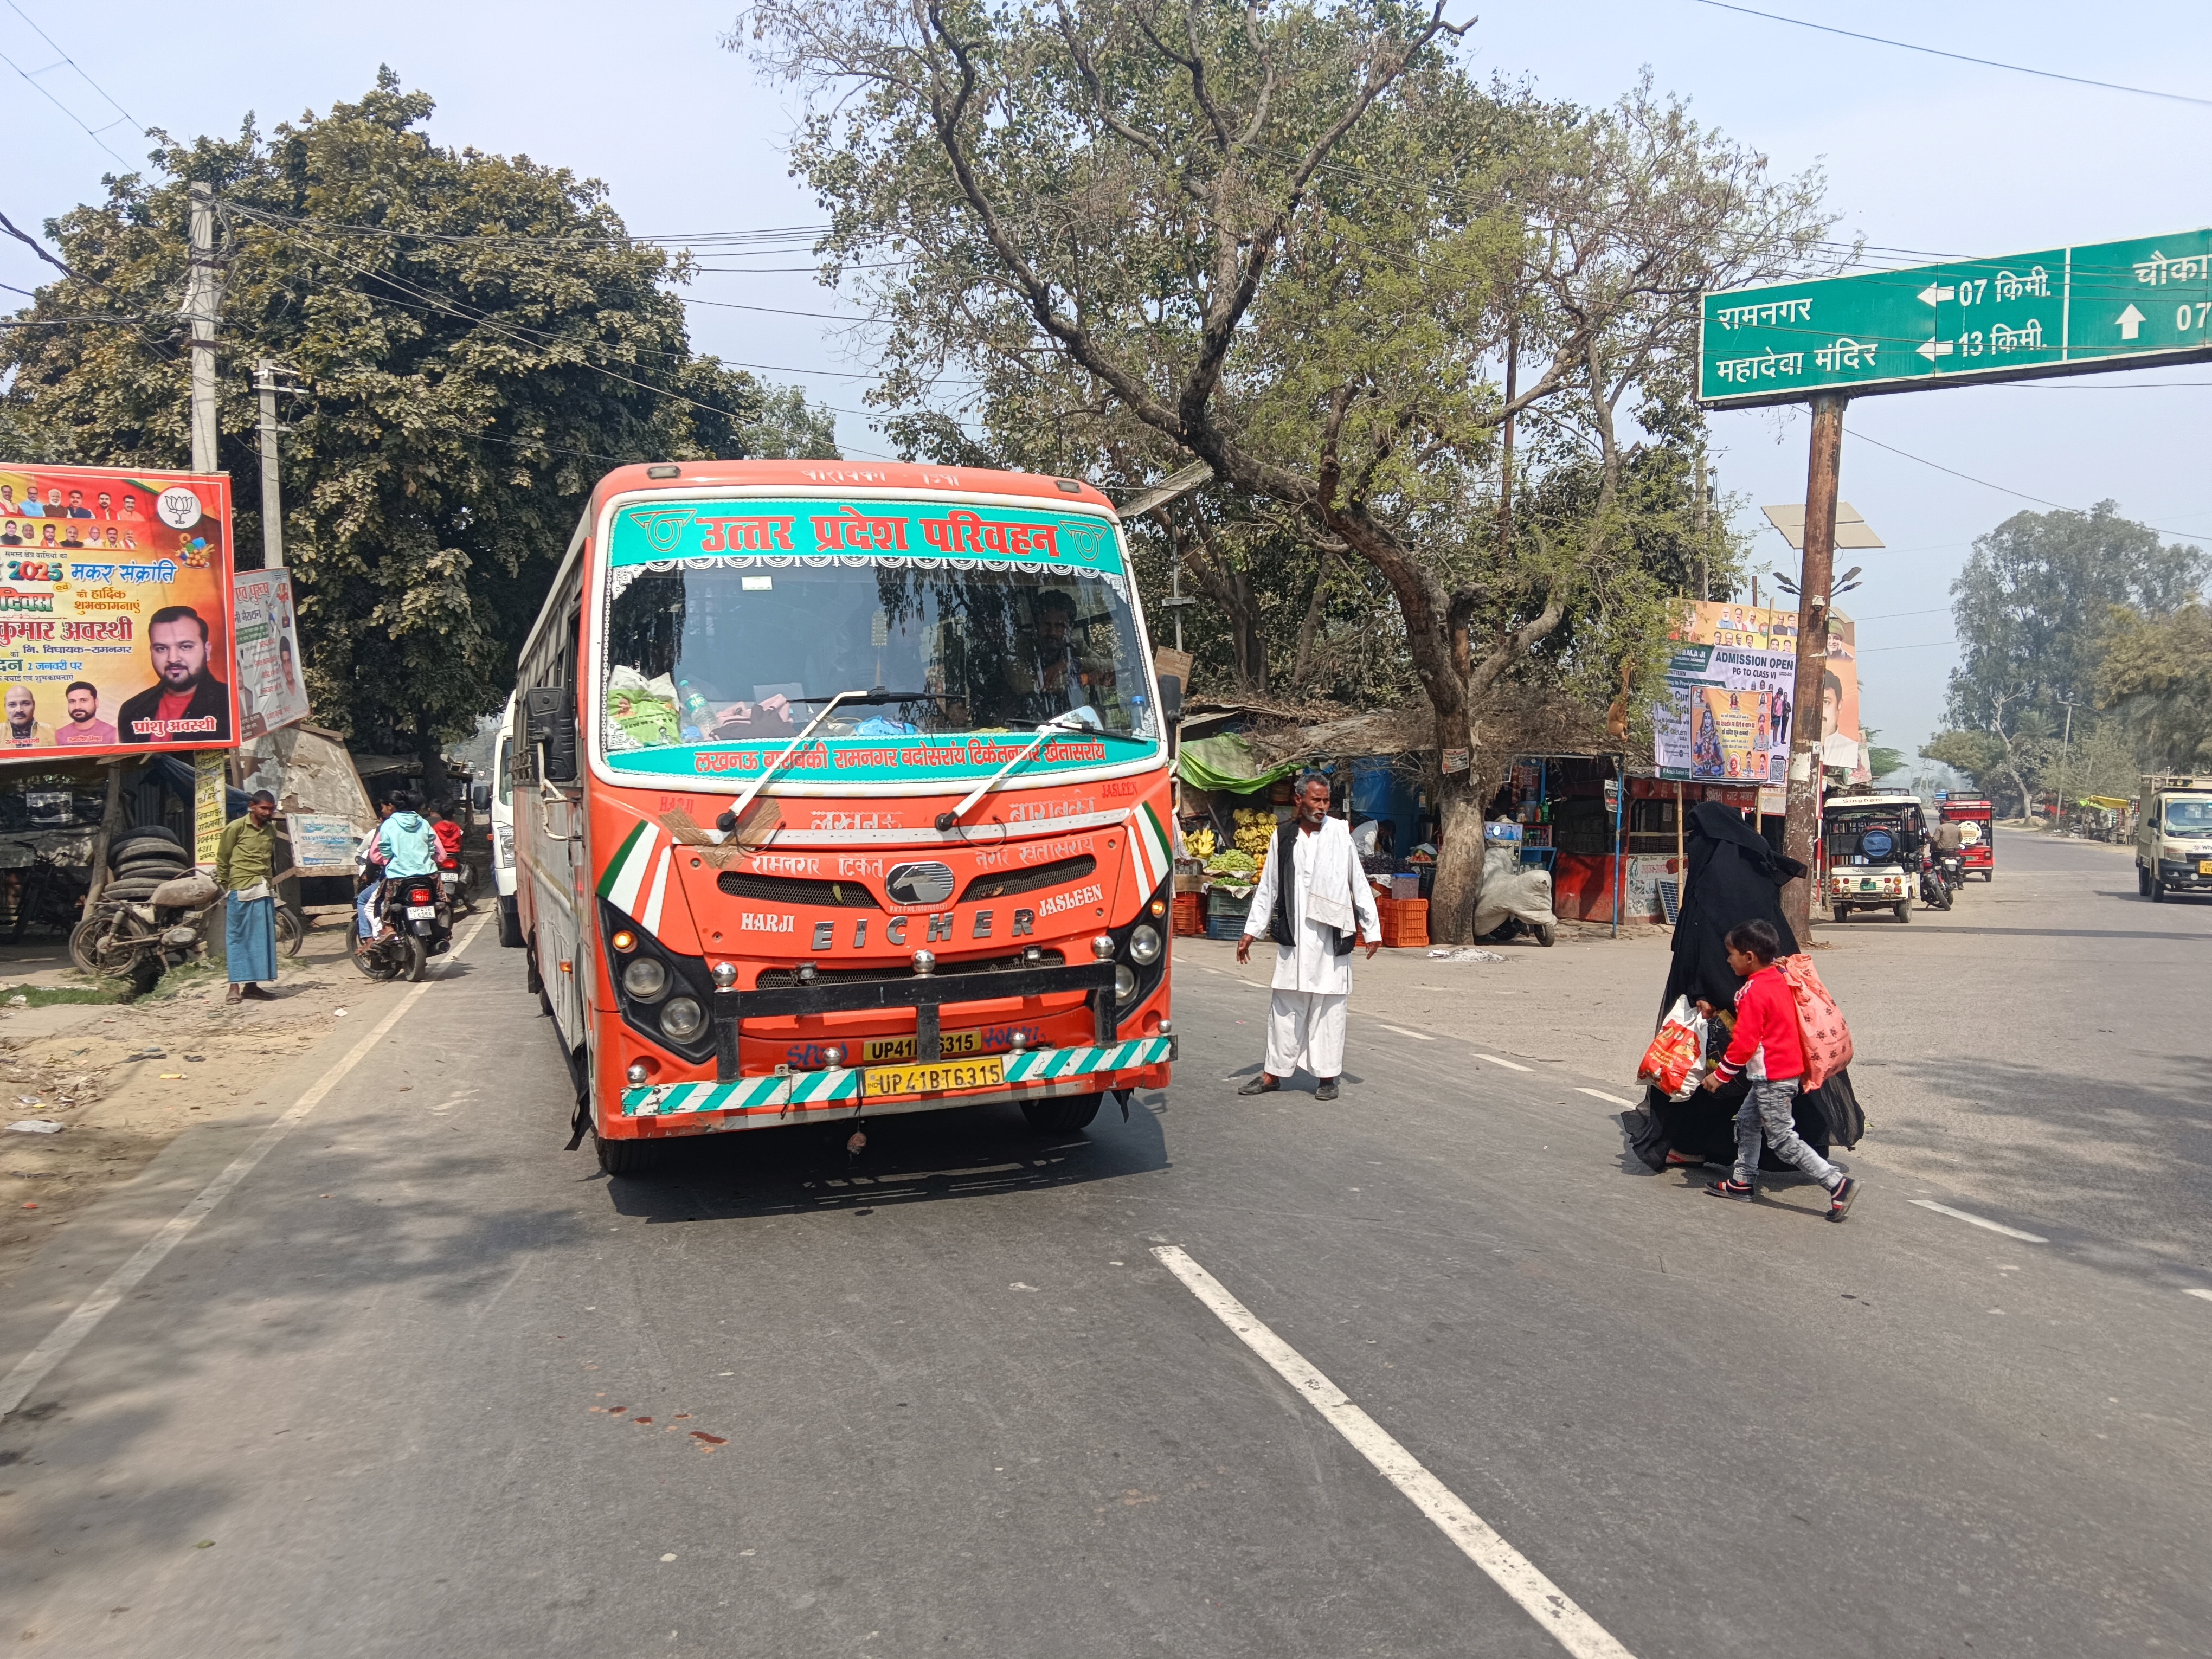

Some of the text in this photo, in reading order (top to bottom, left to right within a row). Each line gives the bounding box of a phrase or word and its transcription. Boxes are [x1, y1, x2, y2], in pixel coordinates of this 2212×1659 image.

[1959, 265, 2051, 306] 07 किमी.
[1717, 298, 1813, 330] रामनगर
[2177, 302, 2212, 331] 07
[1959, 318, 2047, 357] 13 किमी.
[1716, 338, 1879, 383] महादेवा मंदिर
[695, 506, 1060, 557] उत्तर प्रदेश परिवहन
[7, 561, 63, 582] 2025
[71, 564, 115, 583] मकर
[119, 560, 177, 583] संक्रांति
[0, 587, 54, 612] दिवस
[91, 587, 127, 599] हार्दिक
[74, 599, 141, 615] शुभकामनाएं
[0, 616, 133, 646] कुमार अवस्थी
[35, 660, 67, 670] जनवरी
[70, 662, 82, 670] पर
[1715, 652, 1794, 670] ADMISSION OPEN
[1733, 667, 1741, 676] PG
[1743, 668, 1751, 677] TO
[1753, 670, 1769, 678] CLASS
[1770, 671, 1776, 679] VI
[133, 716, 215, 736] प्रांशु अवस्थी
[695, 750, 759, 771] लखनऊ
[833, 748, 898, 768] रामनगर
[901, 741, 966, 766] बदोसरांय
[1102, 782, 1137, 798] JASLEEN
[1727, 791, 1738, 801] चाट
[752, 856, 821, 875] रामनगर
[1039, 884, 1104, 917] JASLEEN
[741, 912, 794, 933] HARJI
[811, 907, 1037, 950] EICHER
[872, 1034, 973, 1059] UP416315
